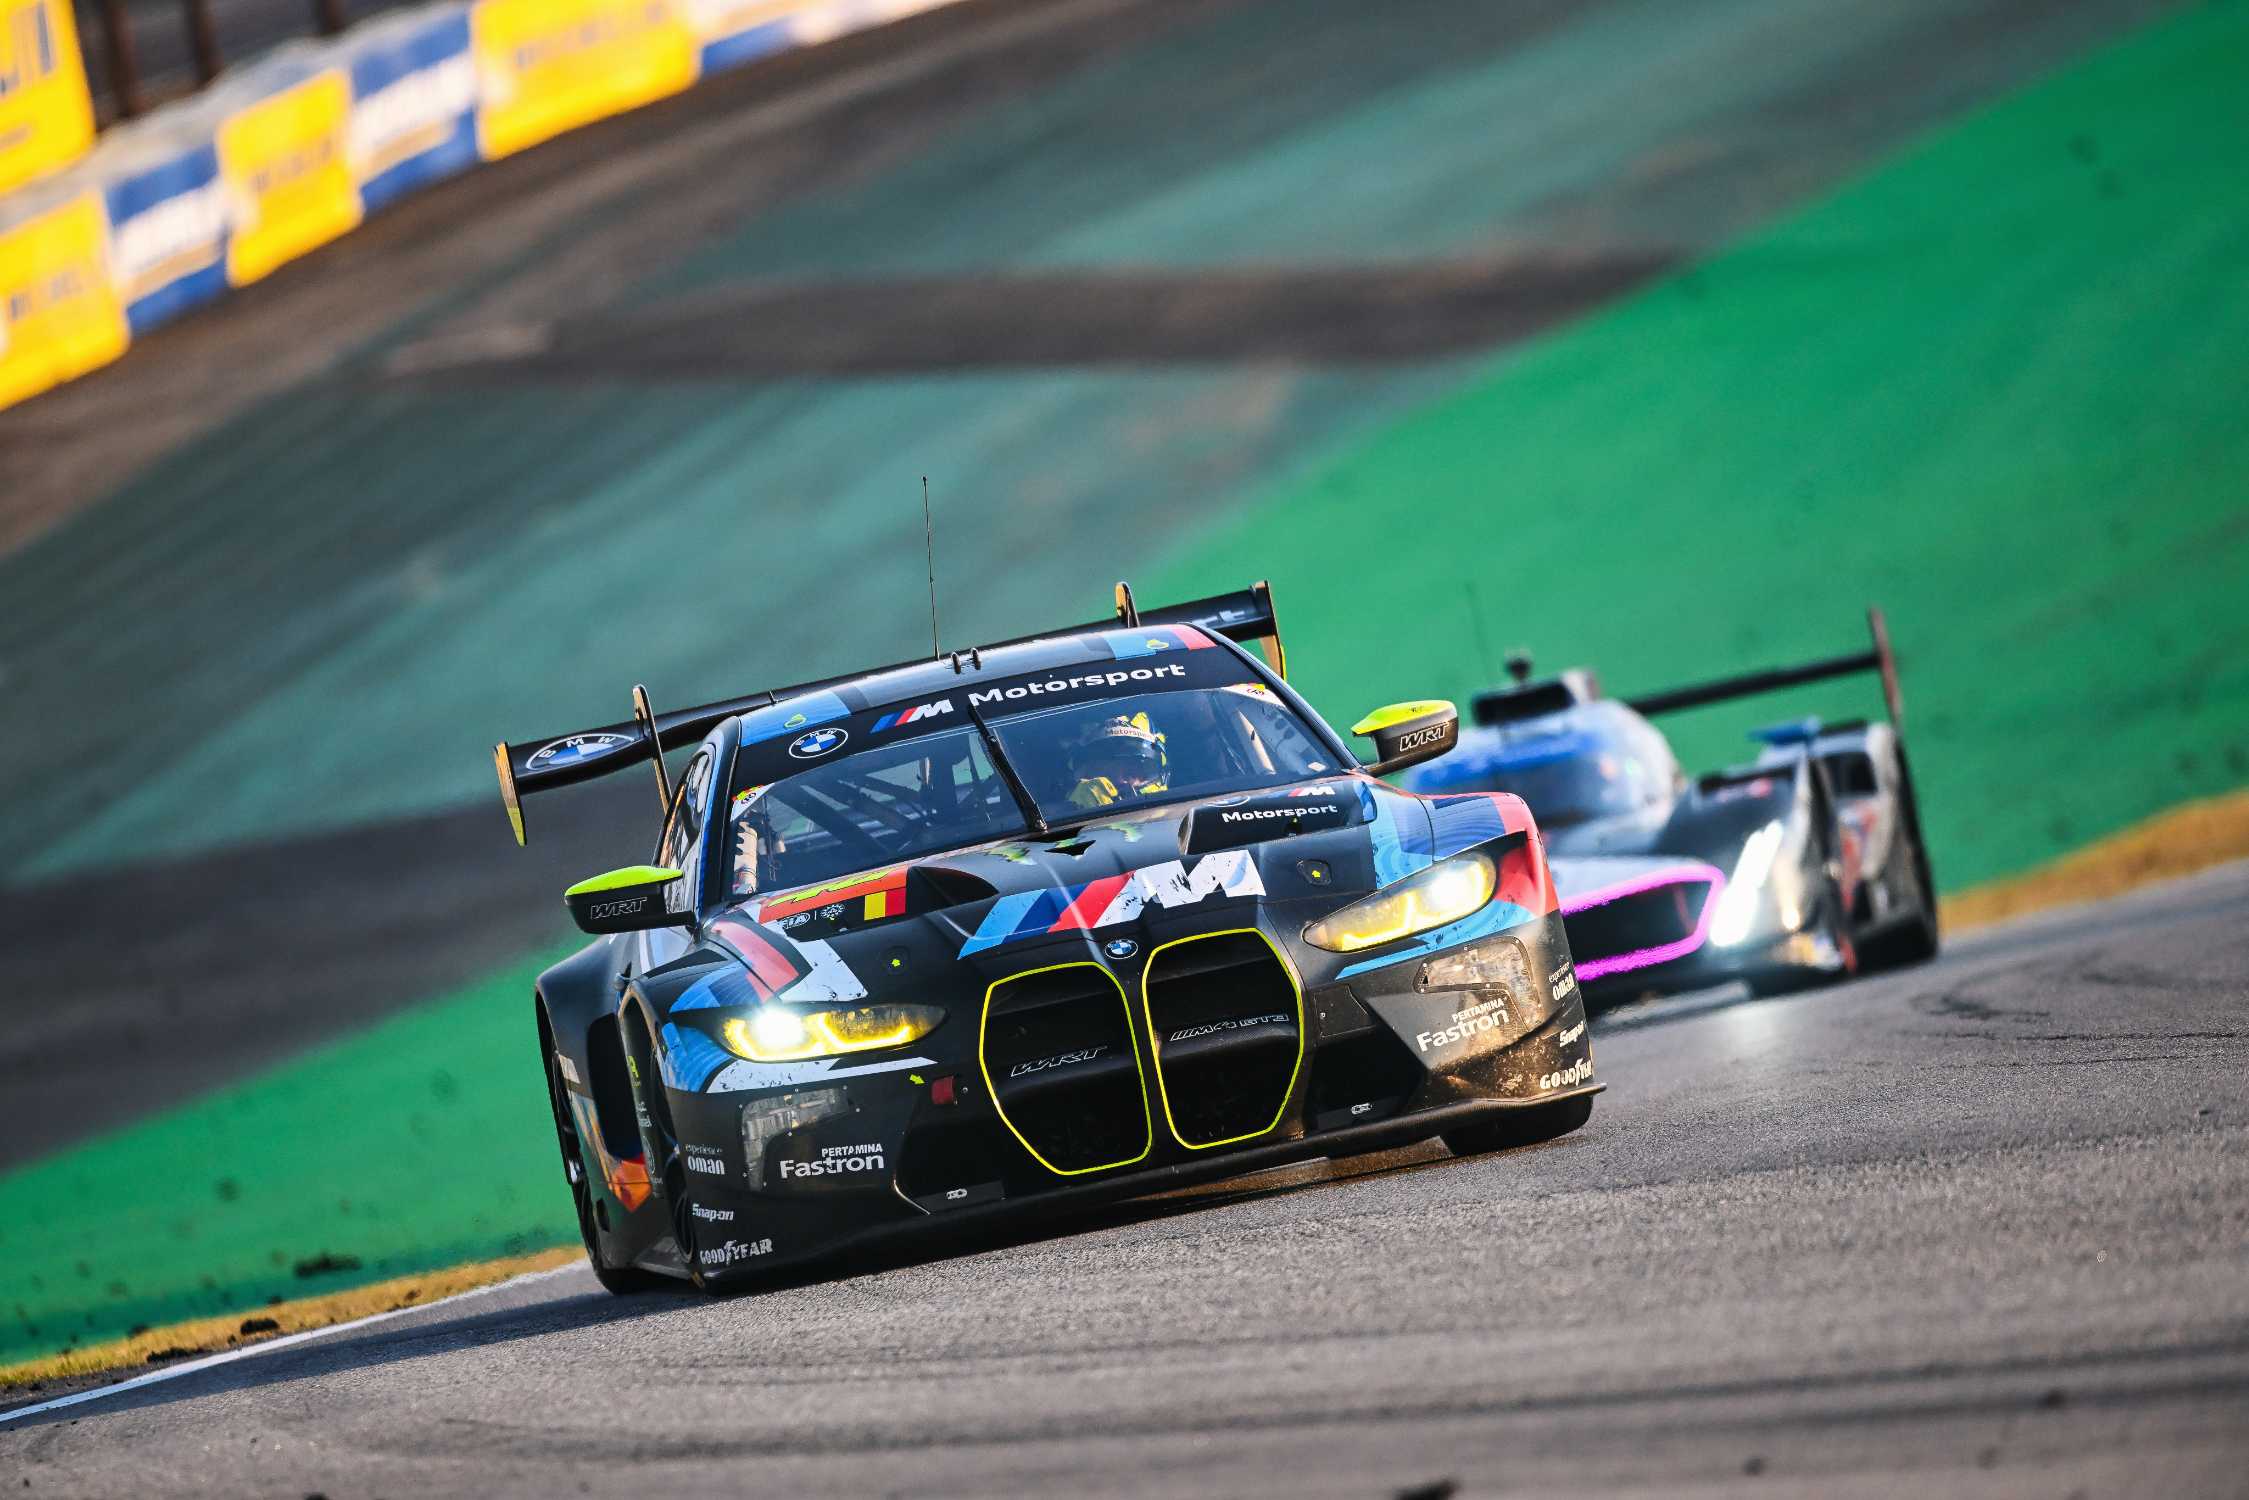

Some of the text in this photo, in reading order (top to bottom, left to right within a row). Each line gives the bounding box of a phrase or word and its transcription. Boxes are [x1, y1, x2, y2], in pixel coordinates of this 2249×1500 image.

[967, 663, 1187, 708] Motorsport
[538, 736, 616, 758] BMW
[1400, 721, 1450, 752] WRT
[1221, 804, 1338, 823] Motorsport
[590, 896, 648, 920] WRT
[1451, 997, 1505, 1023] PERTAMINA
[1416, 1009, 1510, 1052] Fastron
[1010, 1045, 1108, 1078] WRT
[821, 1143, 883, 1158] PERTAMINA
[688, 1155, 725, 1175] oman
[779, 1155, 885, 1179] Fastron
[692, 1203, 734, 1222] Snap-on
[699, 1237, 773, 1266] GOODYEAR
